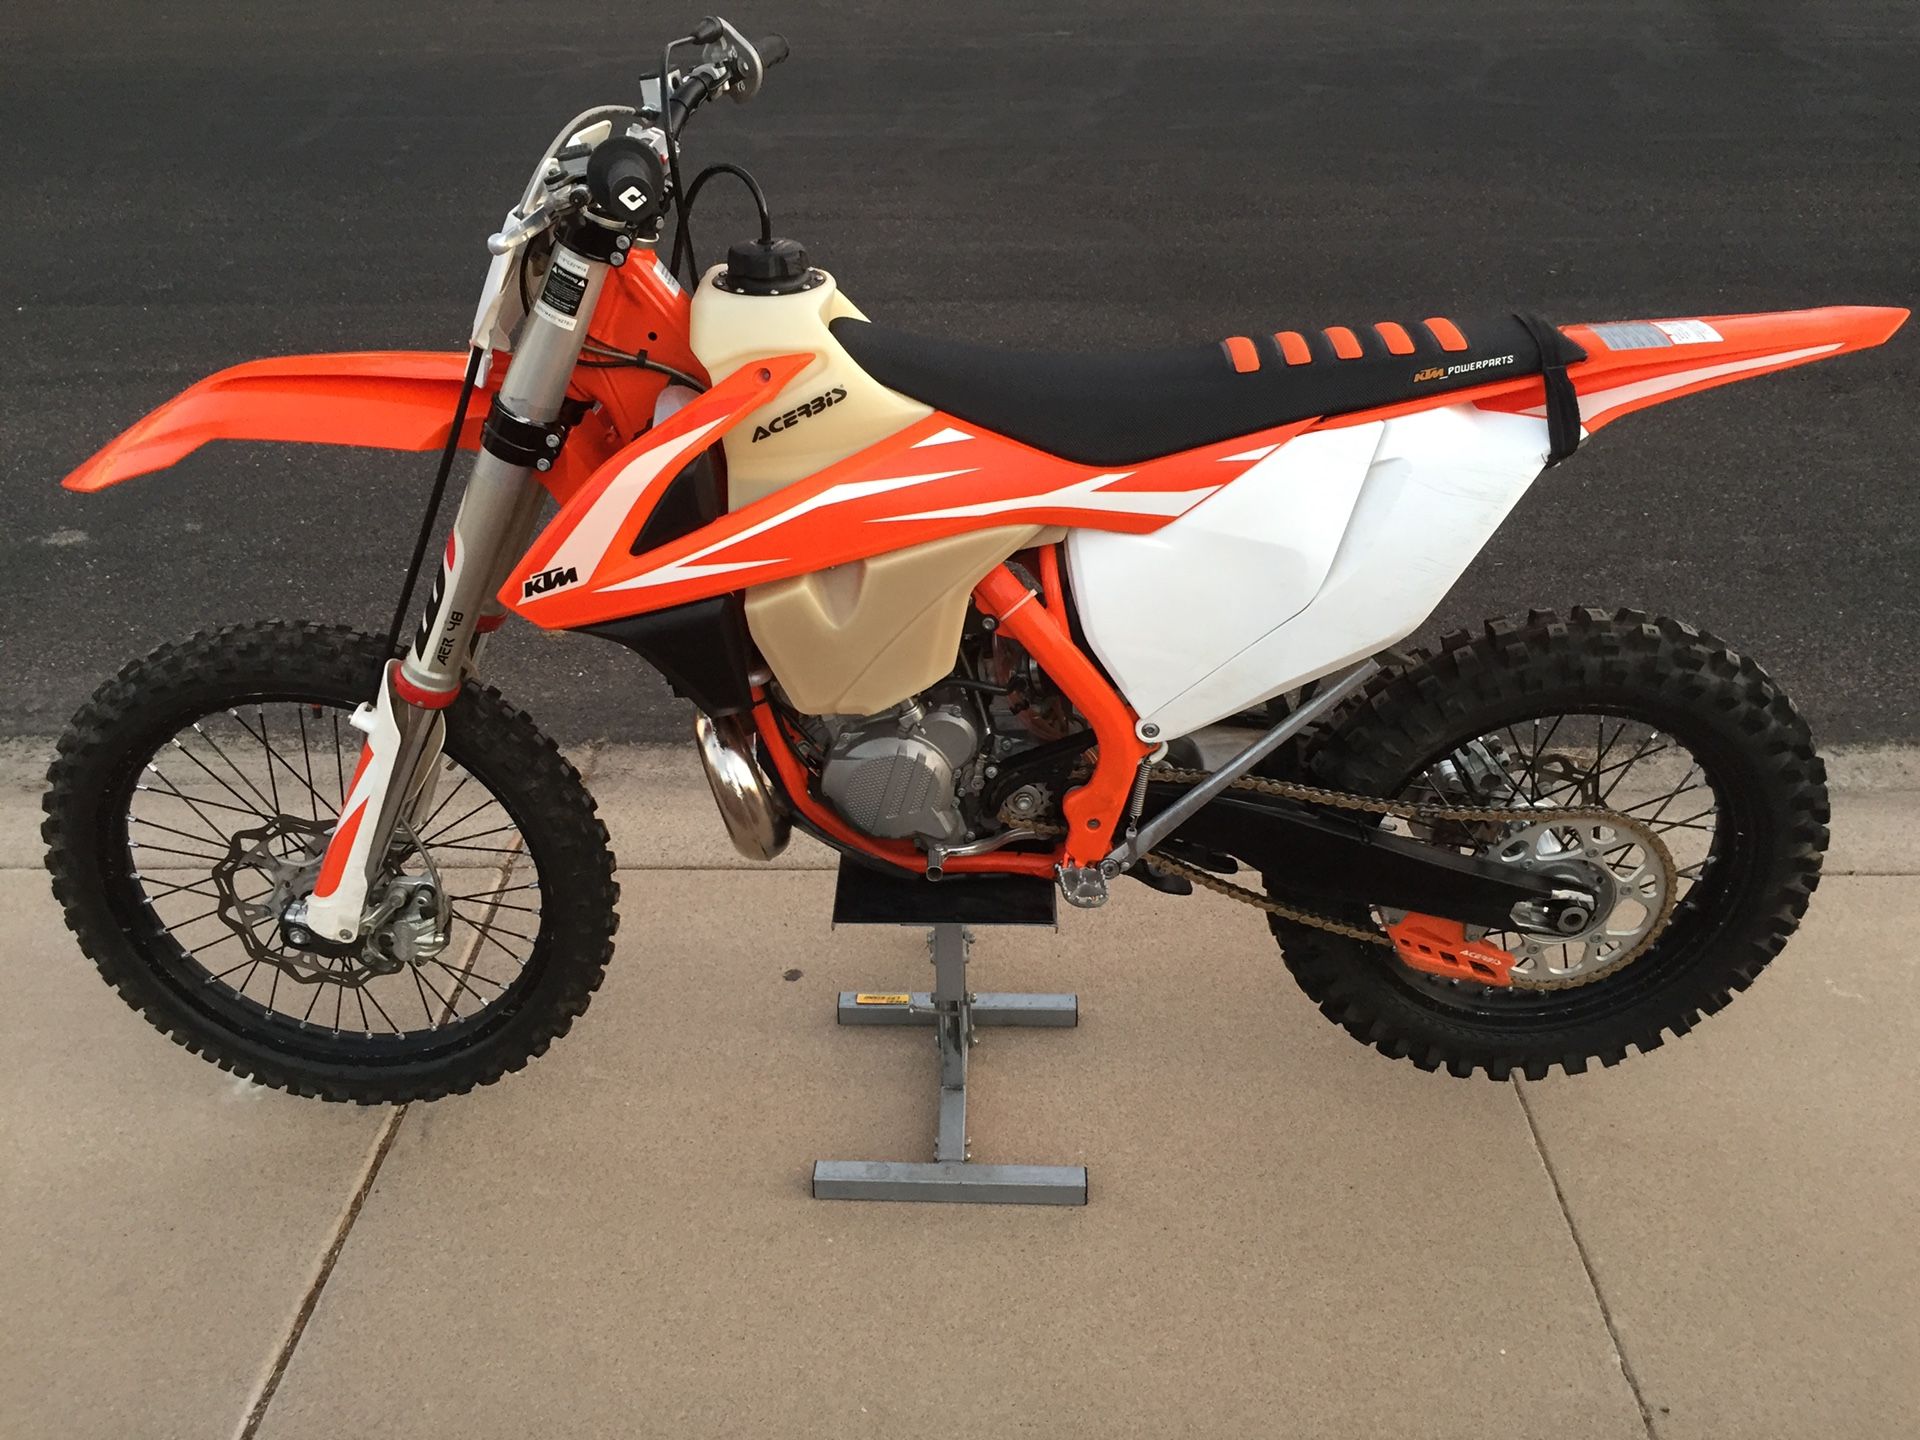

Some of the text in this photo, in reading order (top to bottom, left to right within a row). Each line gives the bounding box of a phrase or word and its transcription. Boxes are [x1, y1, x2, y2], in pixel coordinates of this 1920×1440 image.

[1448, 355, 1514, 375] POWERPARTS
[752, 388, 847, 443] ACERBIS
[525, 567, 578, 598] KTM
[437, 611, 464, 666] AER 48
